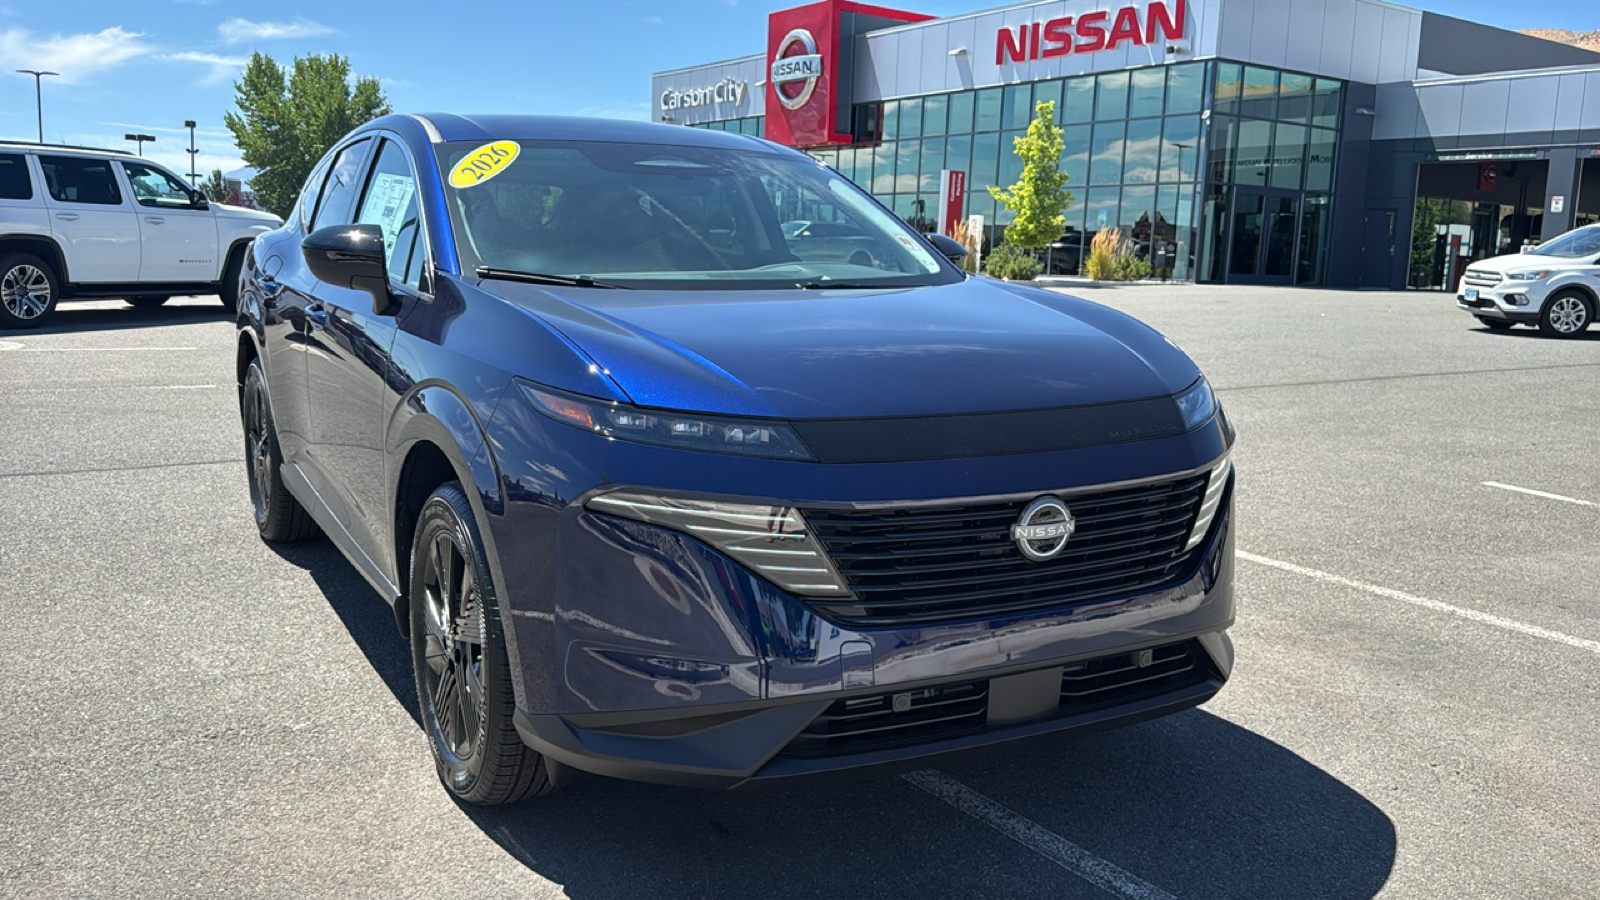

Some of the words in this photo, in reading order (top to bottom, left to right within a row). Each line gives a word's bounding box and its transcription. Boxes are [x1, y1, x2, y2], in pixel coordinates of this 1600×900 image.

[995, 0, 1186, 66] NISSAN
[660, 89, 710, 110] Carson
[714, 78, 745, 107] City
[461, 145, 510, 180] 2026
[1464, 151, 1493, 160] Service
[1017, 522, 1074, 537] NISSAN
